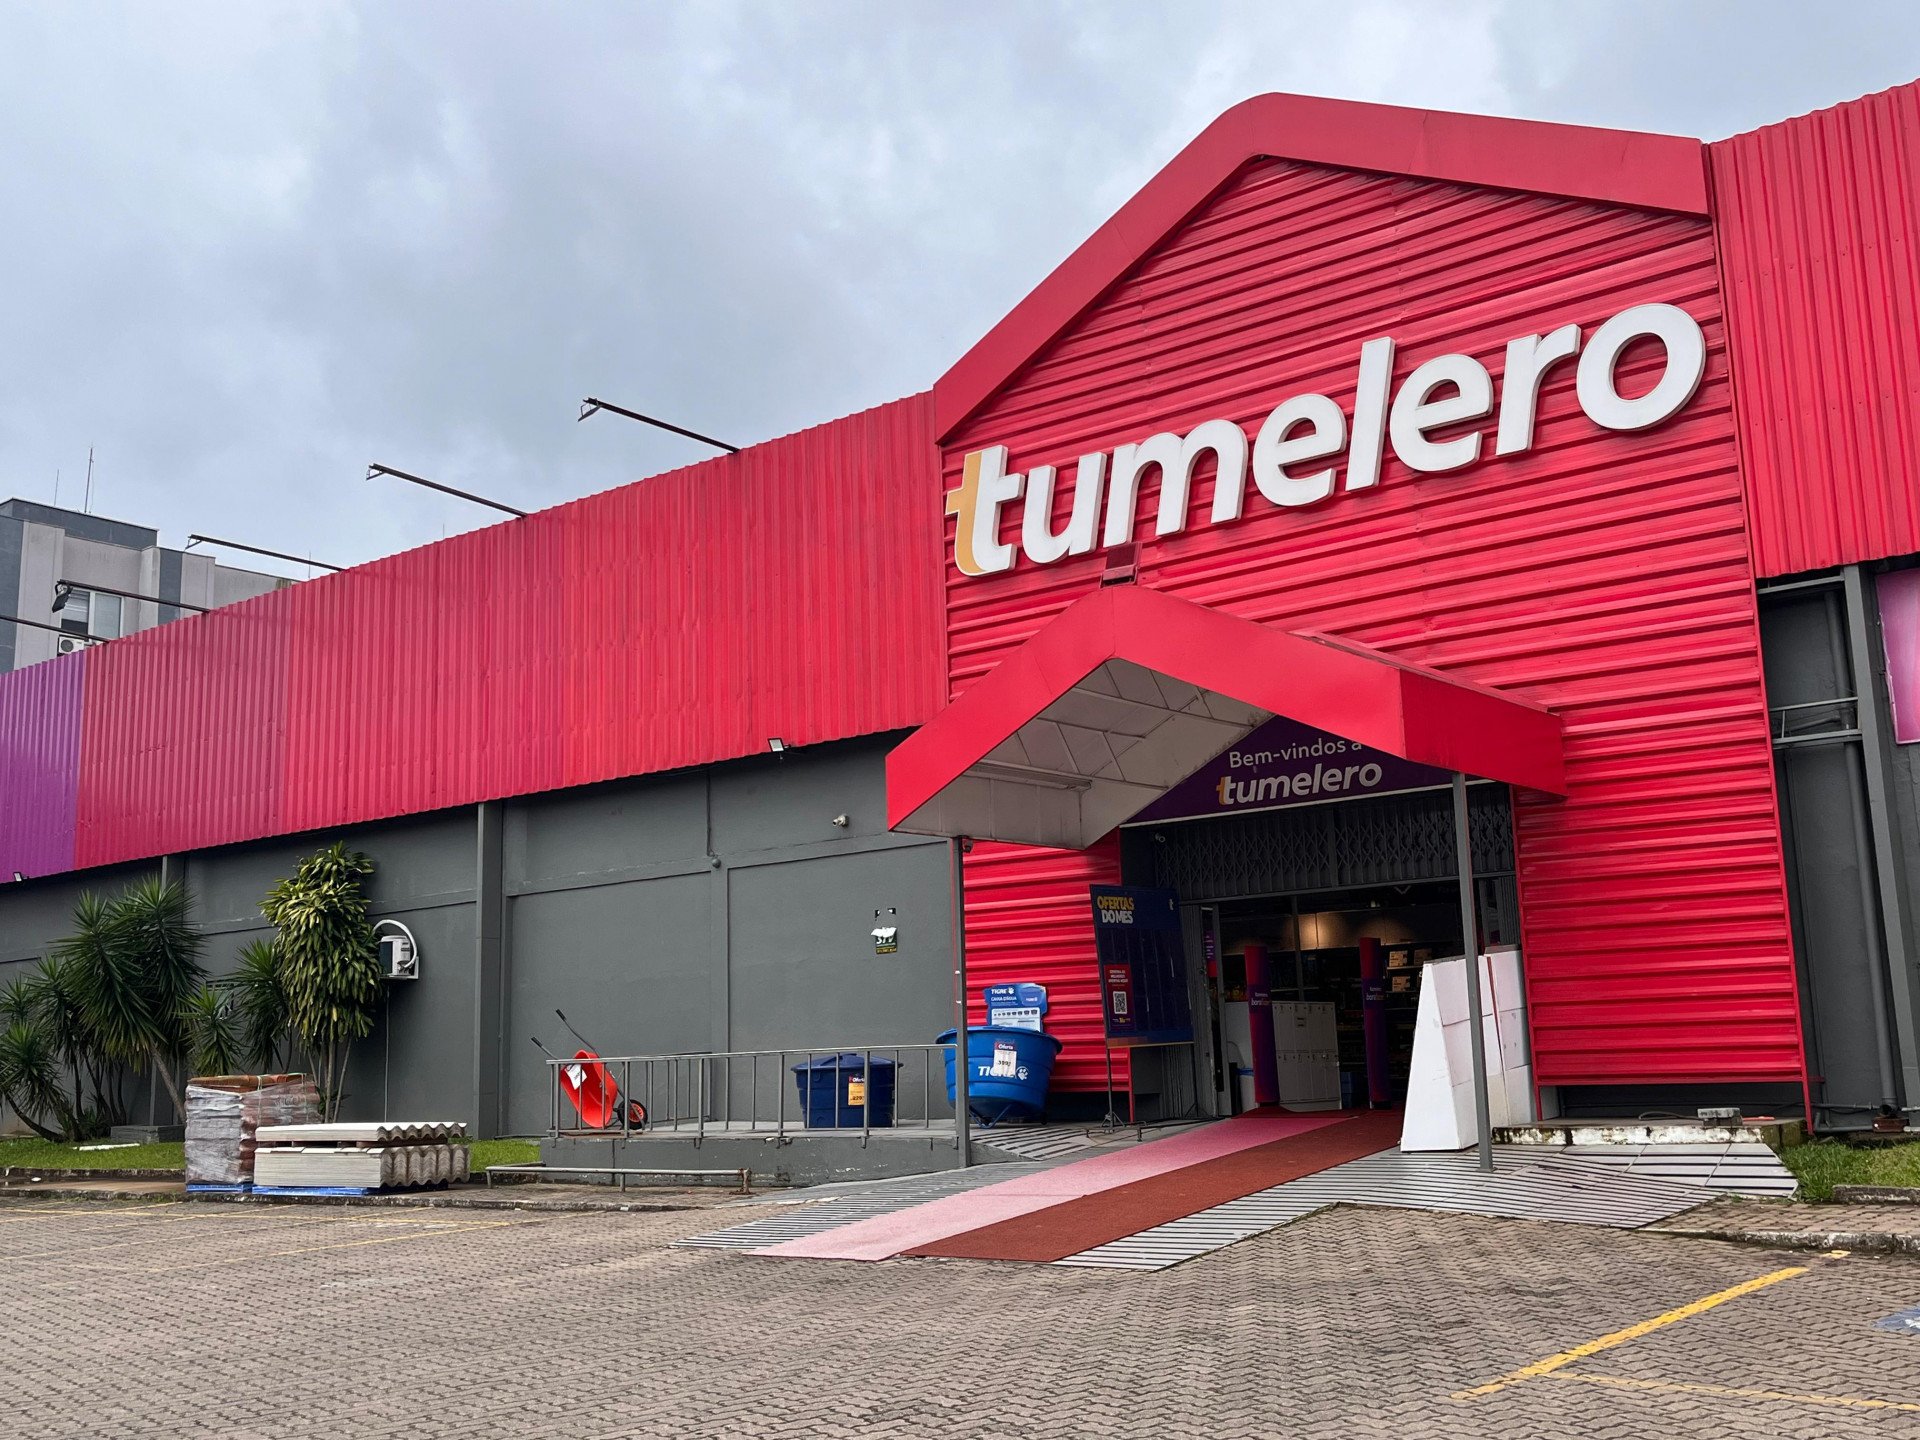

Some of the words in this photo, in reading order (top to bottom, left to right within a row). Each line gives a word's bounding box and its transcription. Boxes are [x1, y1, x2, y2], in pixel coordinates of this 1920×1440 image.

[945, 303, 1706, 577] tumelero
[1229, 738, 1346, 768] Bem-vindos
[1216, 763, 1383, 806] tumelero
[1097, 896, 1135, 910] OFERTAS
[1101, 910, 1115, 923] DO
